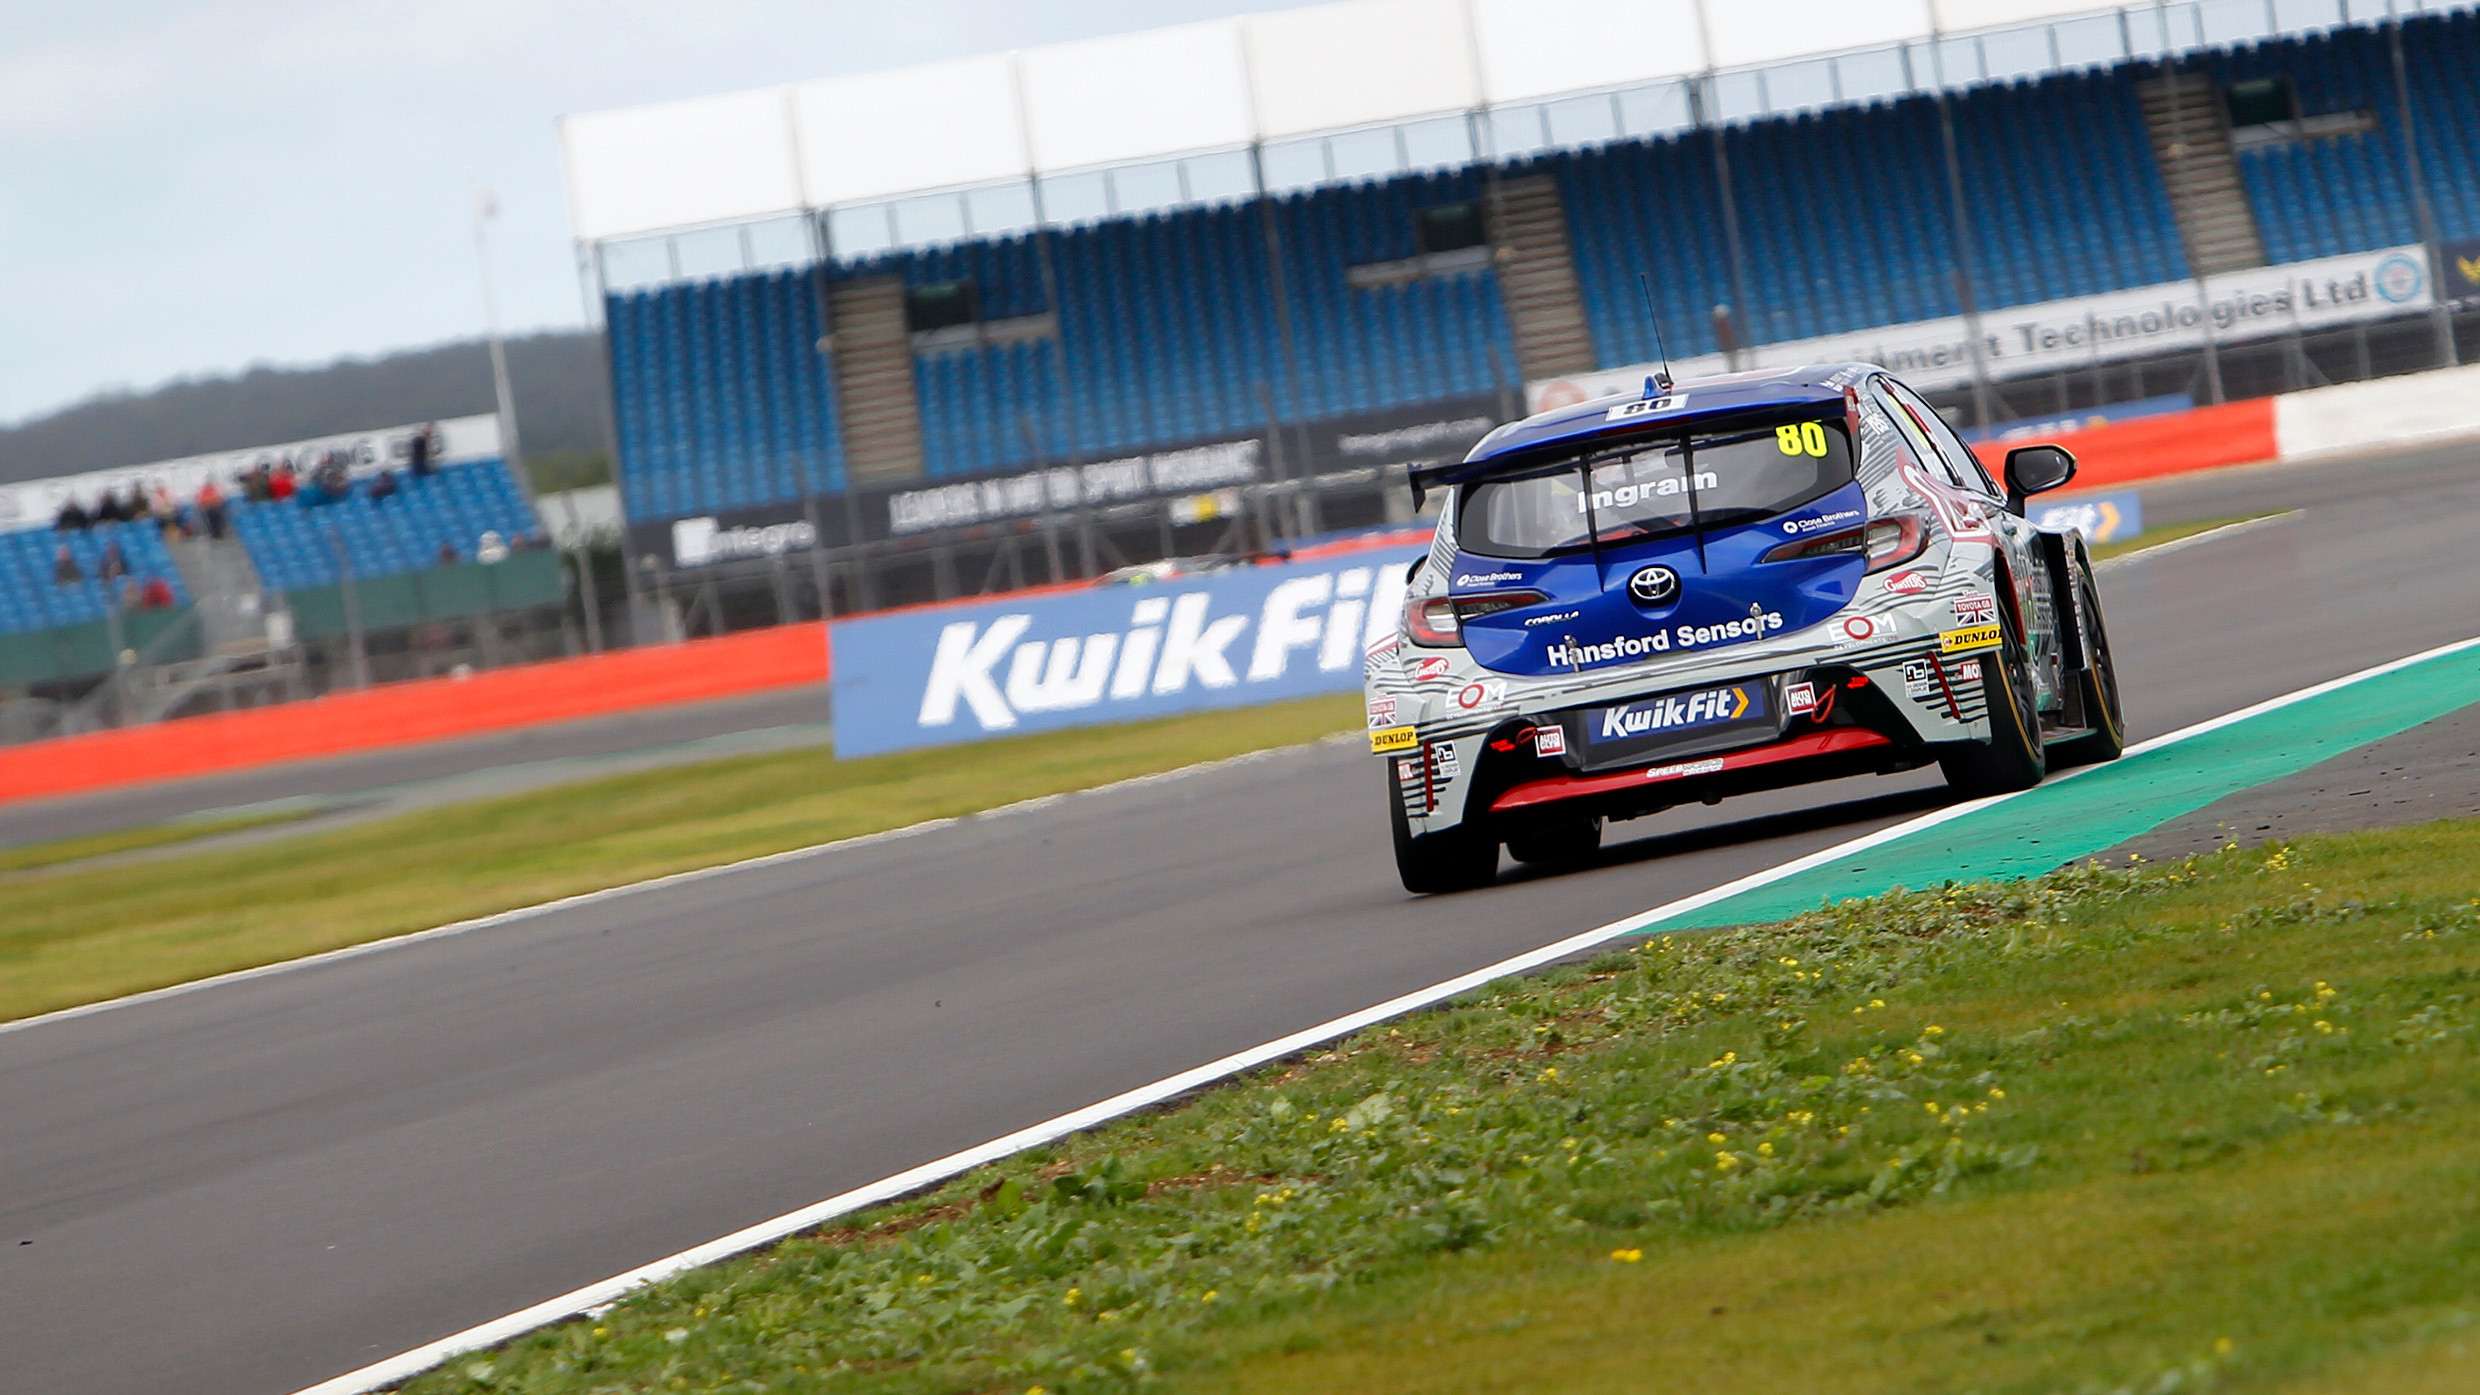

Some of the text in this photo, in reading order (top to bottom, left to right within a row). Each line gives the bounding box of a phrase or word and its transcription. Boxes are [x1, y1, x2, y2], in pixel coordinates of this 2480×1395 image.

[2013, 286, 2291, 351] Technologies
[2303, 271, 2368, 308] Ltd
[1623, 398, 1672, 415] 80
[1775, 421, 1828, 458] 80
[1577, 471, 1718, 514] Ingram
[1798, 510, 1860, 529] Close Brothers
[1490, 572, 1523, 581] Brothers
[1957, 601, 1982, 611] TOYOTA
[1547, 611, 1784, 667] Hansford Sensors
[1826, 612, 1897, 642] EOM
[1445, 681, 1508, 709] EOM
[1374, 731, 1413, 746] DUNLOP
